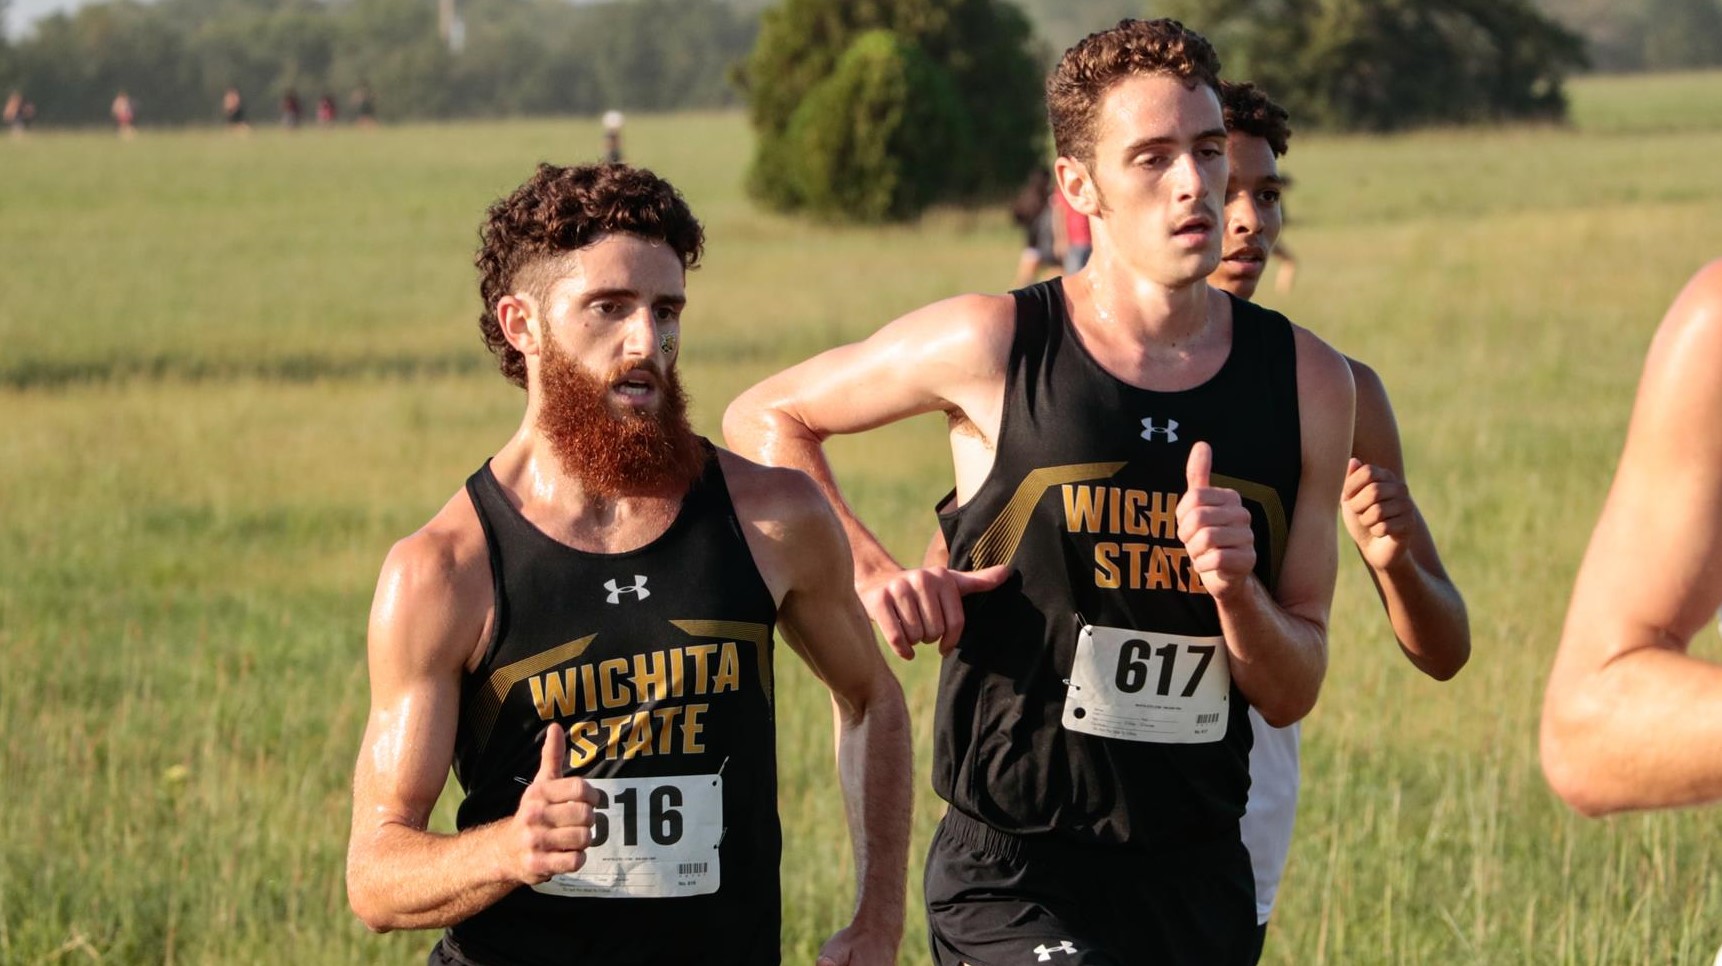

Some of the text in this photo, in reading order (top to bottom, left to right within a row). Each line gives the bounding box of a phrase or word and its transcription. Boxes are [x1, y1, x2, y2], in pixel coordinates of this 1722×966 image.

[1061, 484, 1178, 539] WICH
[528, 642, 739, 721] WICHITA
[1115, 638, 1217, 698] 617
[569, 703, 709, 768] STATE
